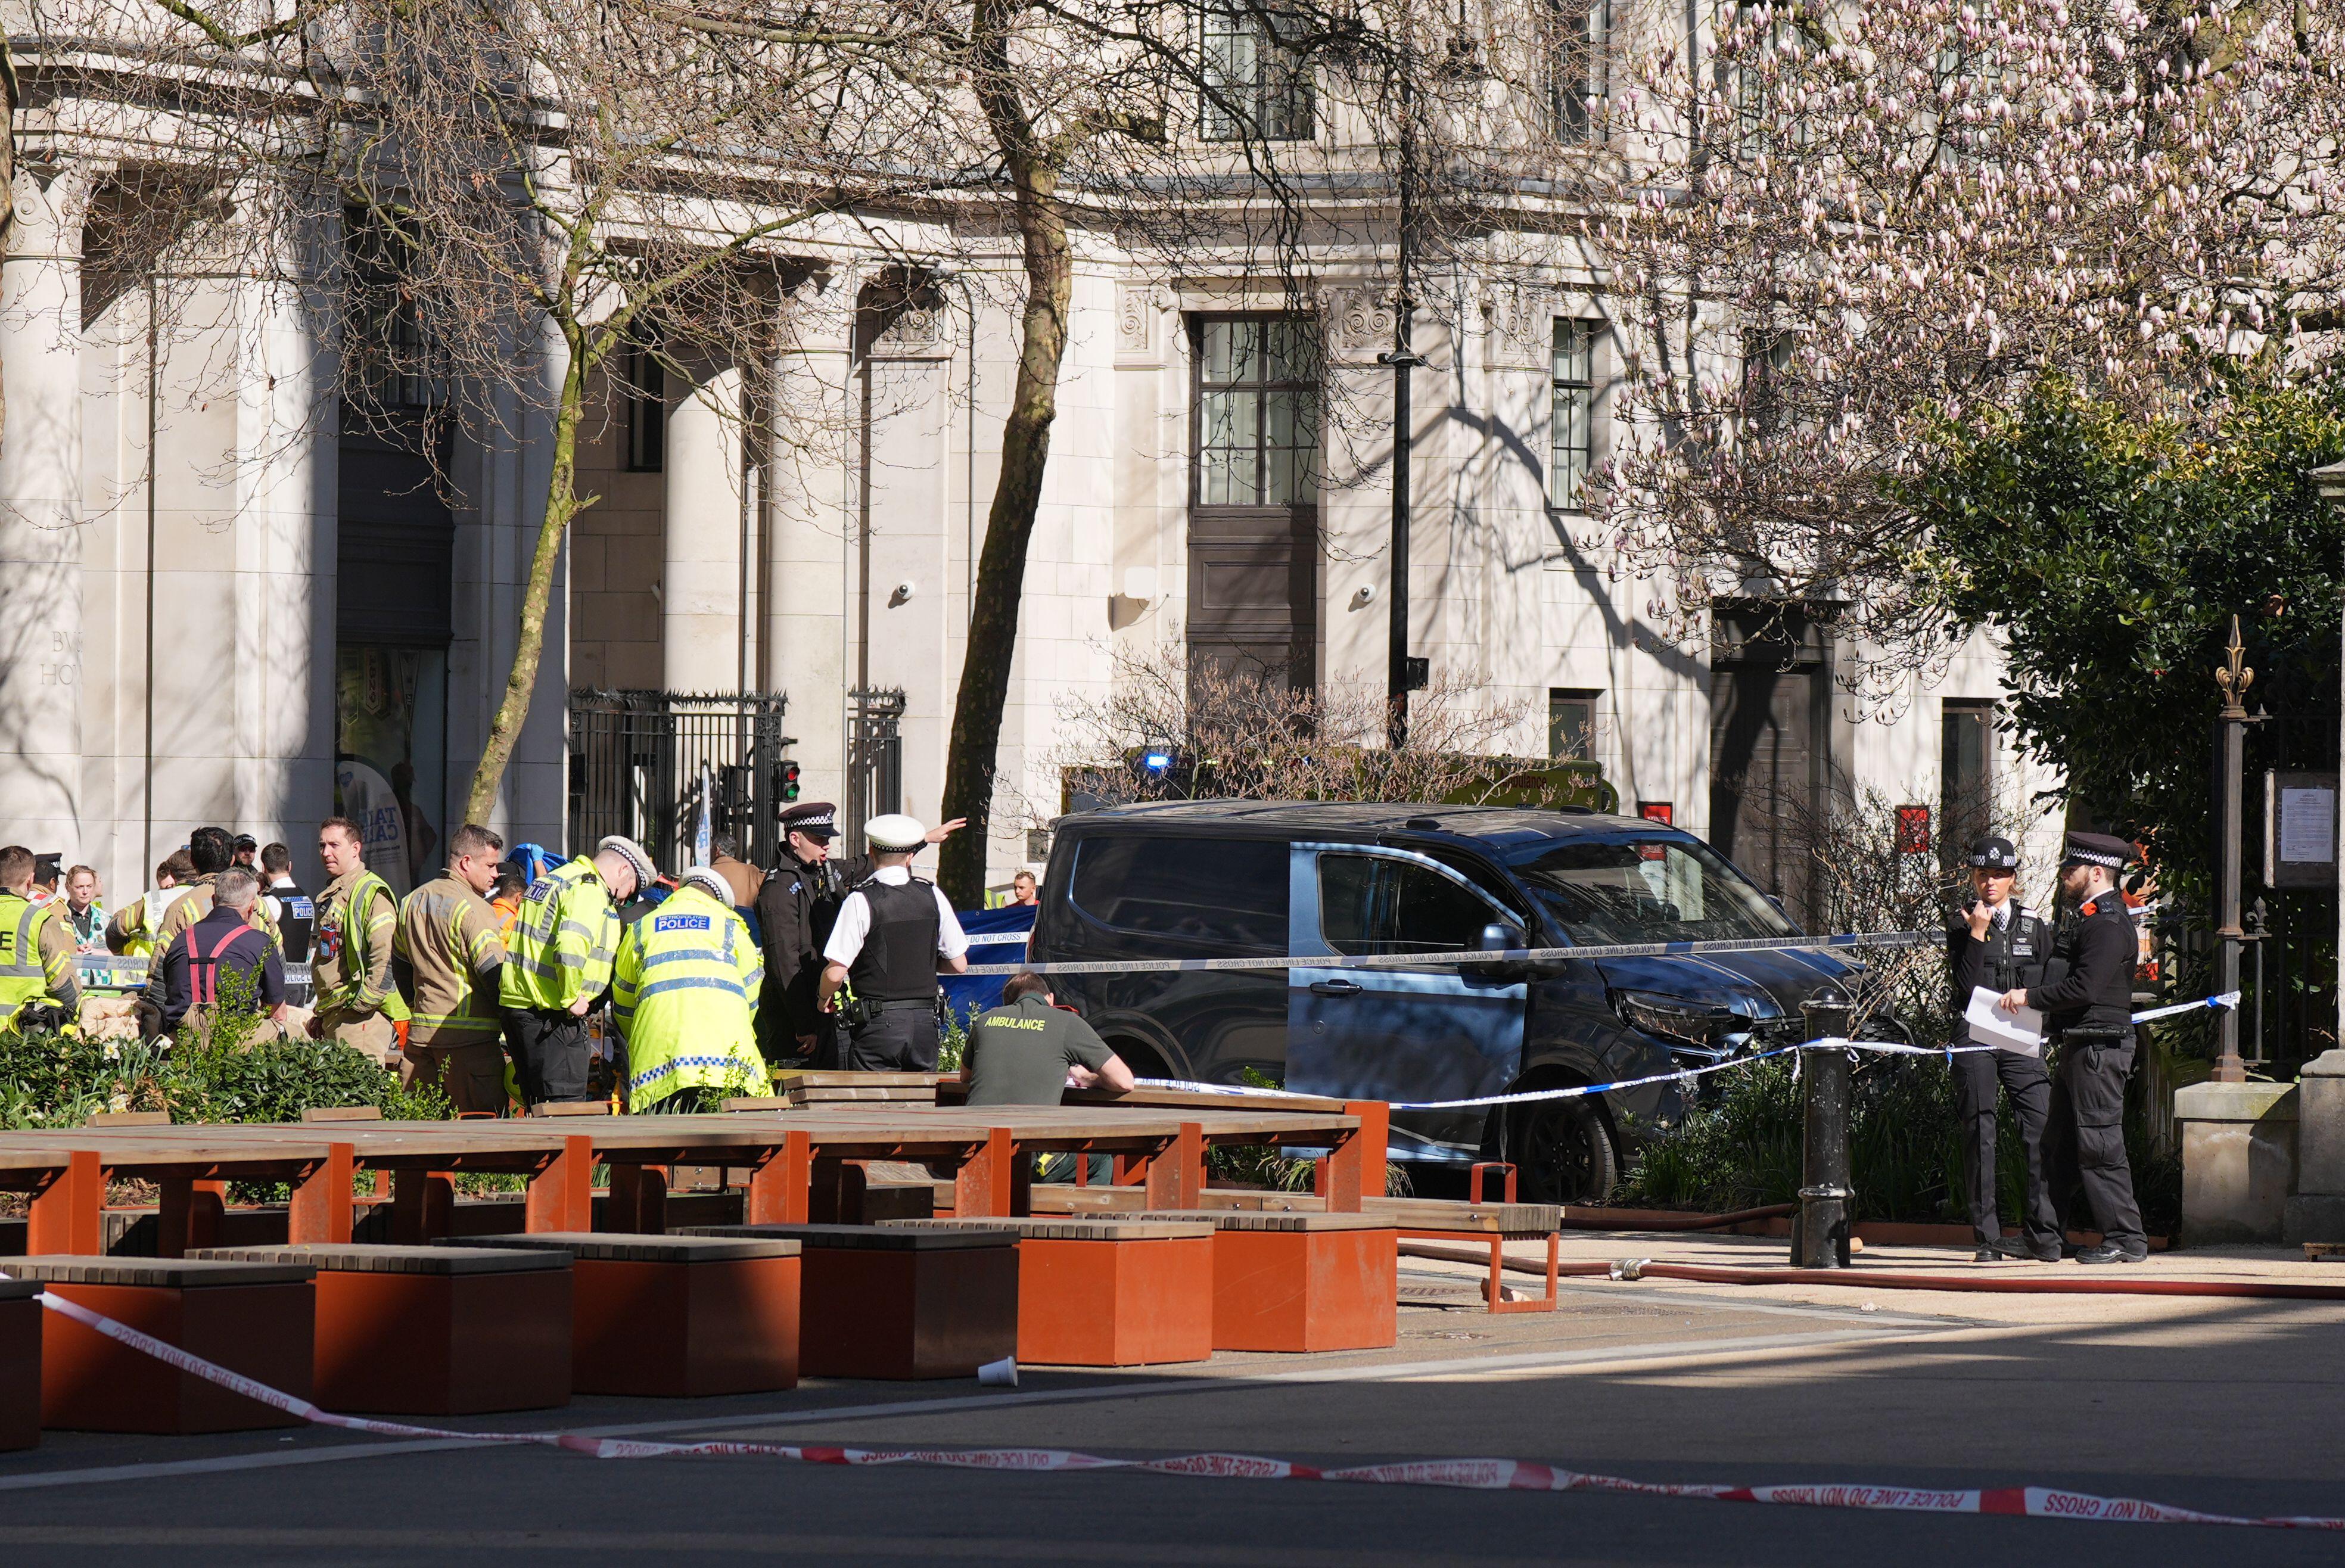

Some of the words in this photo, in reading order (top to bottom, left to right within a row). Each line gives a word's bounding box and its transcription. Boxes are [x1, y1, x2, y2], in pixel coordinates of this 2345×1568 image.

[1500, 770, 1547, 789] Abulance
[524, 885, 549, 901] OLICE
[658, 919, 707, 931] POLICE
[971, 935, 981, 944] DO
[982, 934, 997, 943] NOT
[997, 933, 1021, 941] CROSS
[984, 1016, 1046, 1031] AMBULANCE
[1871, 1489, 1909, 1507] LINE
[1908, 1492, 1965, 1508] POLICE
[2044, 1494, 2101, 1516] CROSS
[2101, 1501, 2136, 1519] NOT
